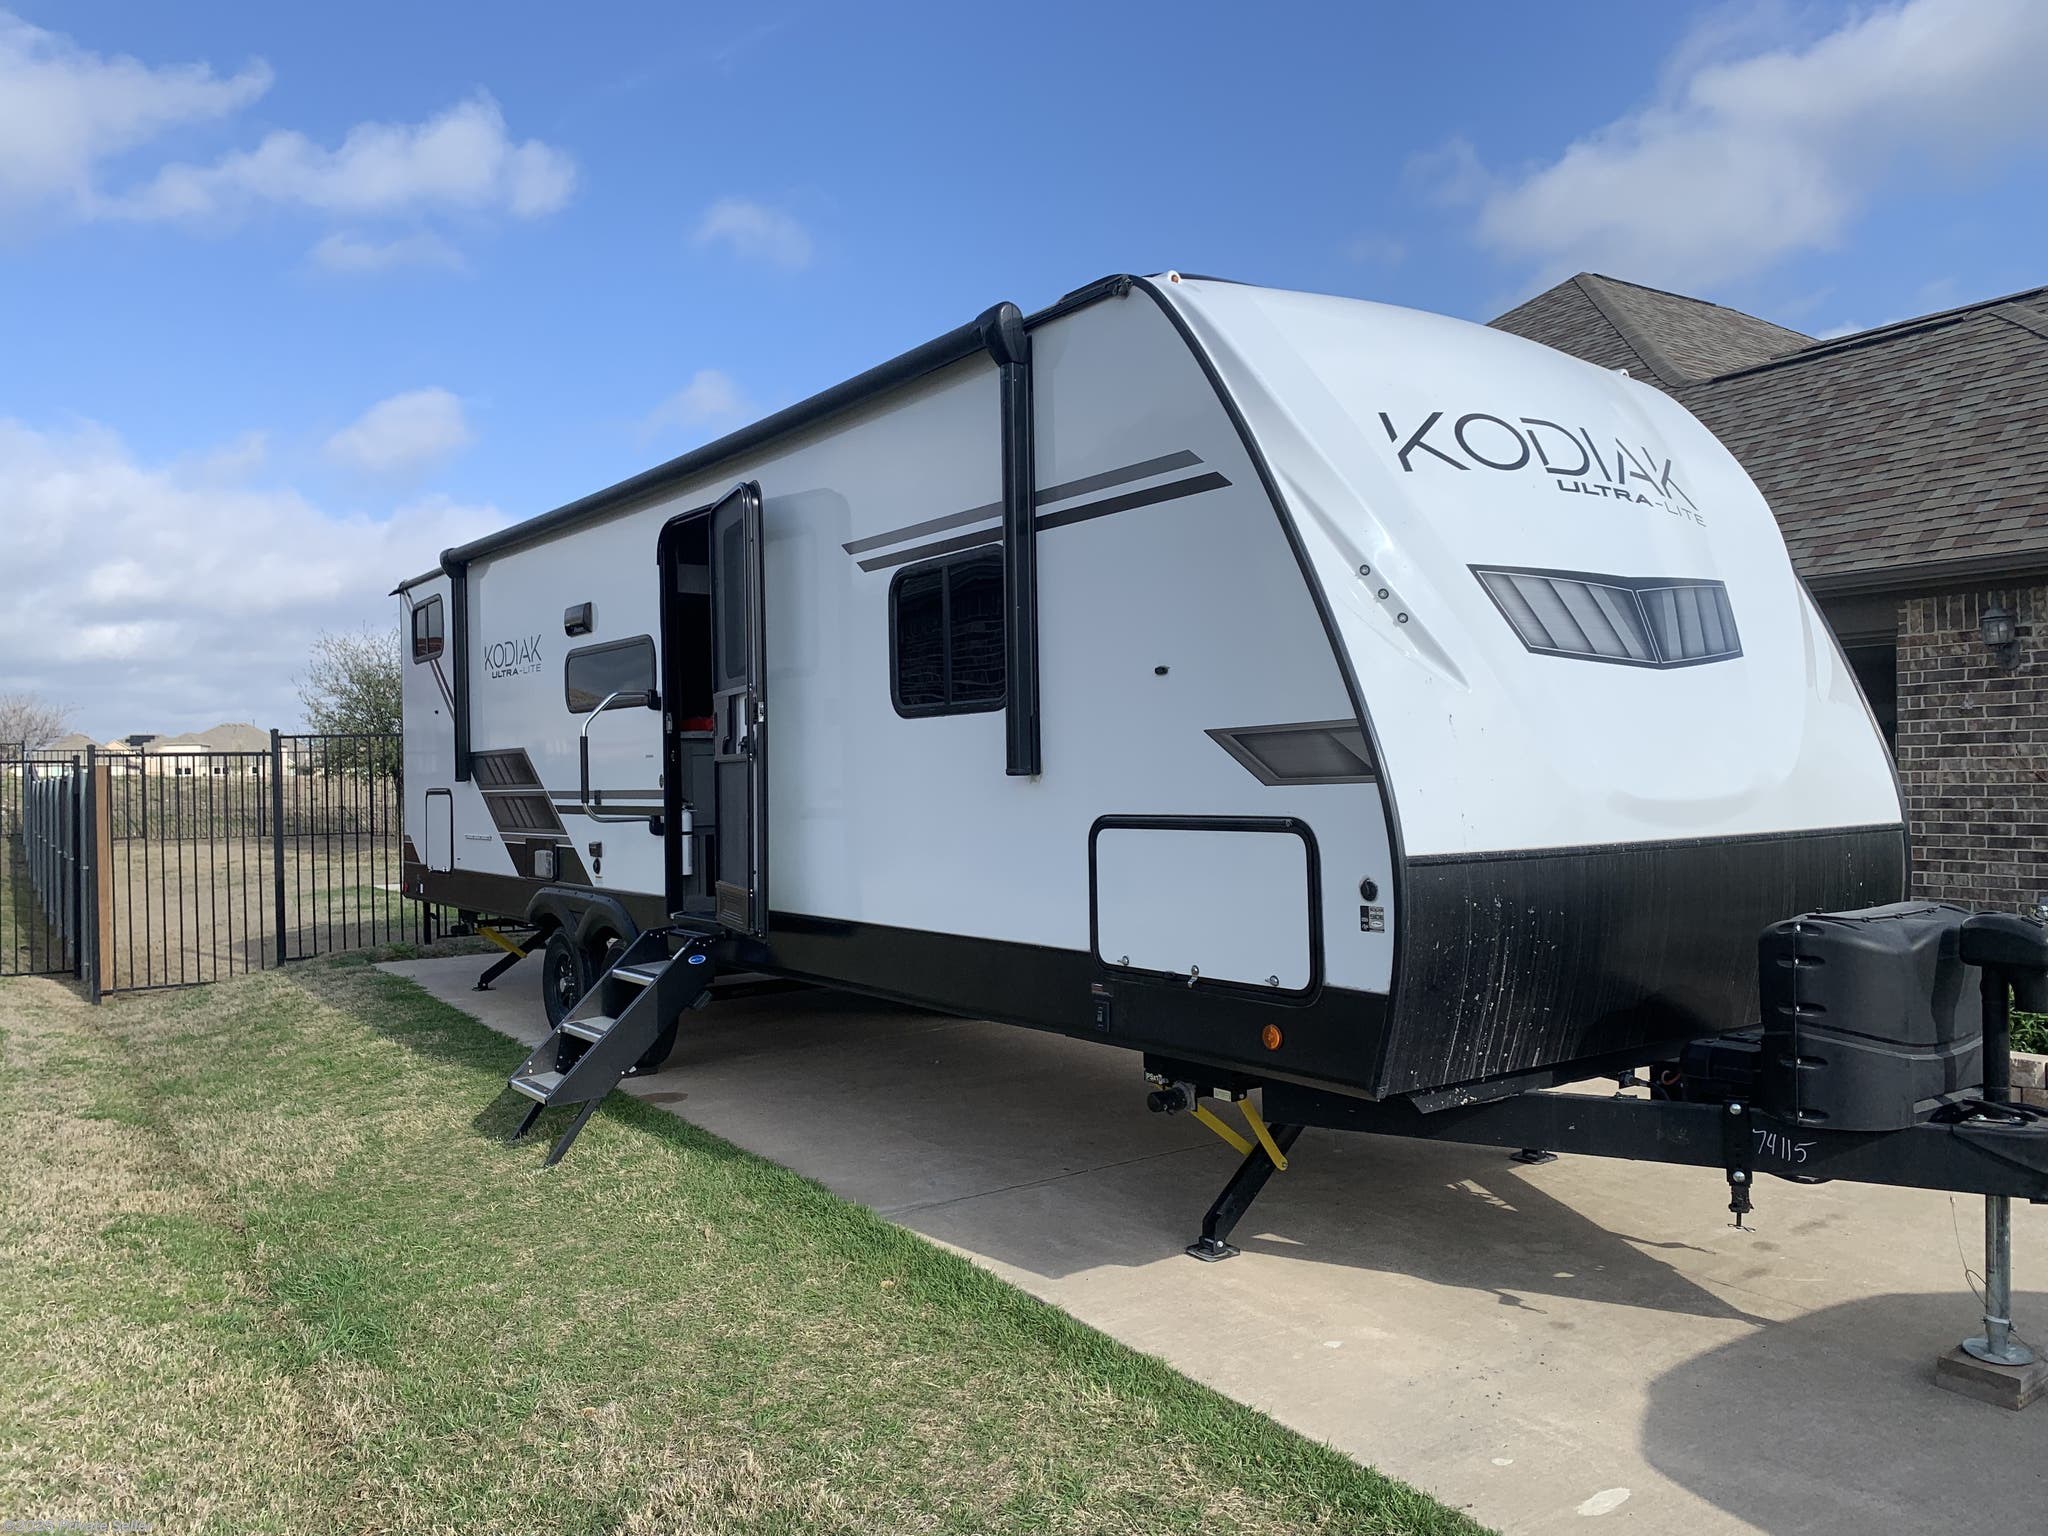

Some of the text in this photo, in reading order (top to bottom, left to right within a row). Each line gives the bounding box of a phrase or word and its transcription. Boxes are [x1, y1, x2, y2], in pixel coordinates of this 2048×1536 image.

[1378, 411, 1699, 511] KODIAK
[1556, 479, 1707, 528] ULTRA-LITE
[484, 634, 542, 671] KODIAK
[491, 663, 542, 679] ULTRA-LITE
[1752, 1128, 1818, 1163] 74115
